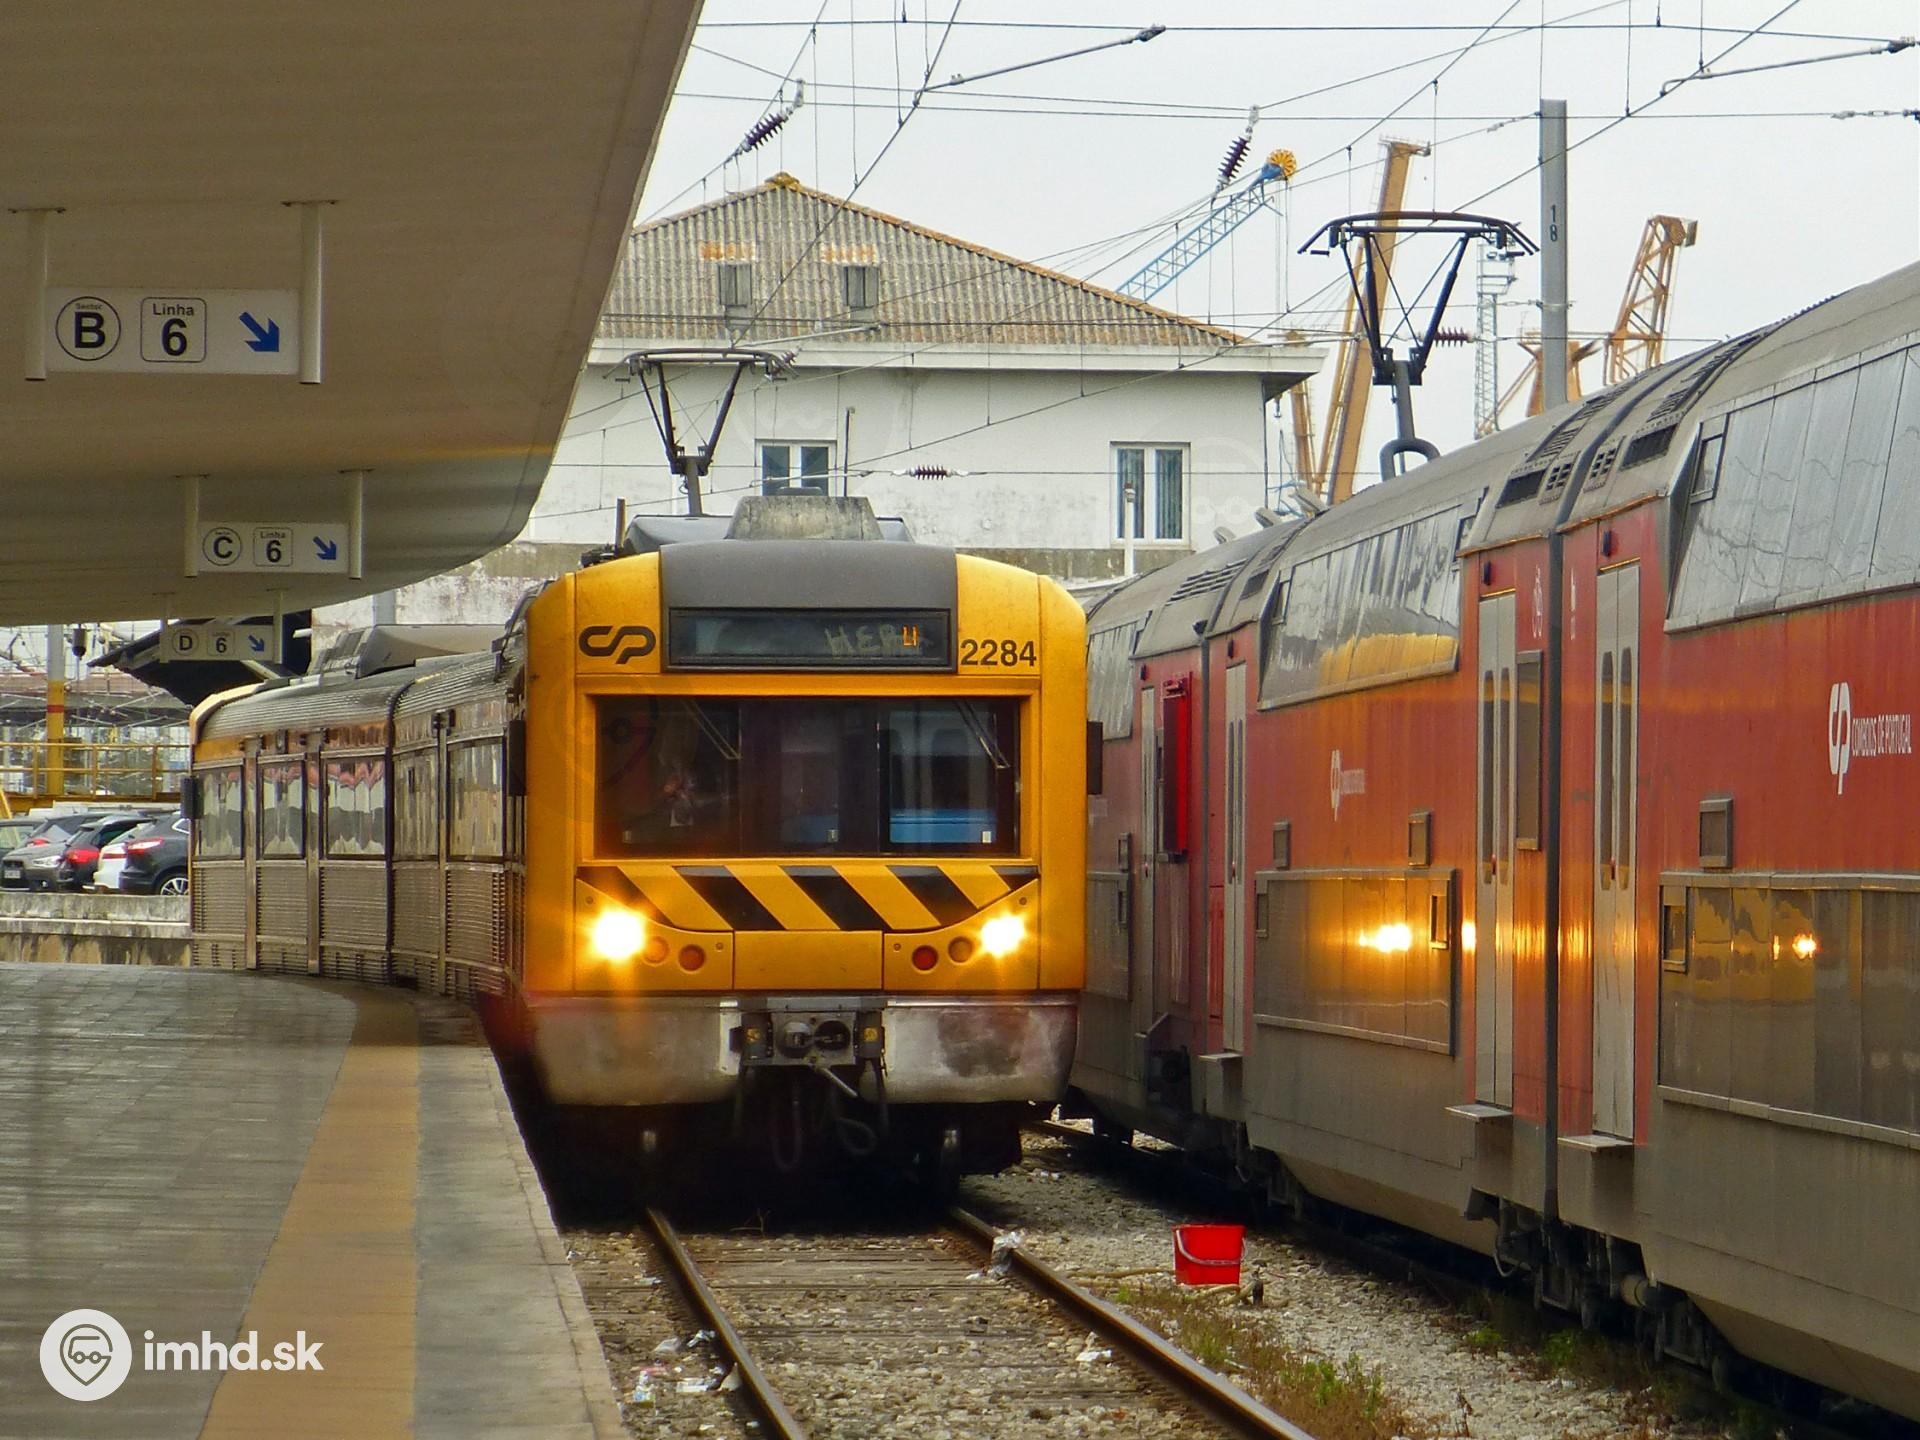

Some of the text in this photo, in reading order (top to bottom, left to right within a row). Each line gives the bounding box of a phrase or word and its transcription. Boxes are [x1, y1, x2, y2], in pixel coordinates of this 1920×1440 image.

[152, 303, 195, 316] Linha
[74, 311, 106, 349] B
[161, 317, 188, 357] 6
[213, 536, 233, 559] C
[266, 540, 282, 563] 6
[179, 635, 193, 651] D
[215, 637, 227, 653] 6
[960, 638, 1037, 667] 2284
